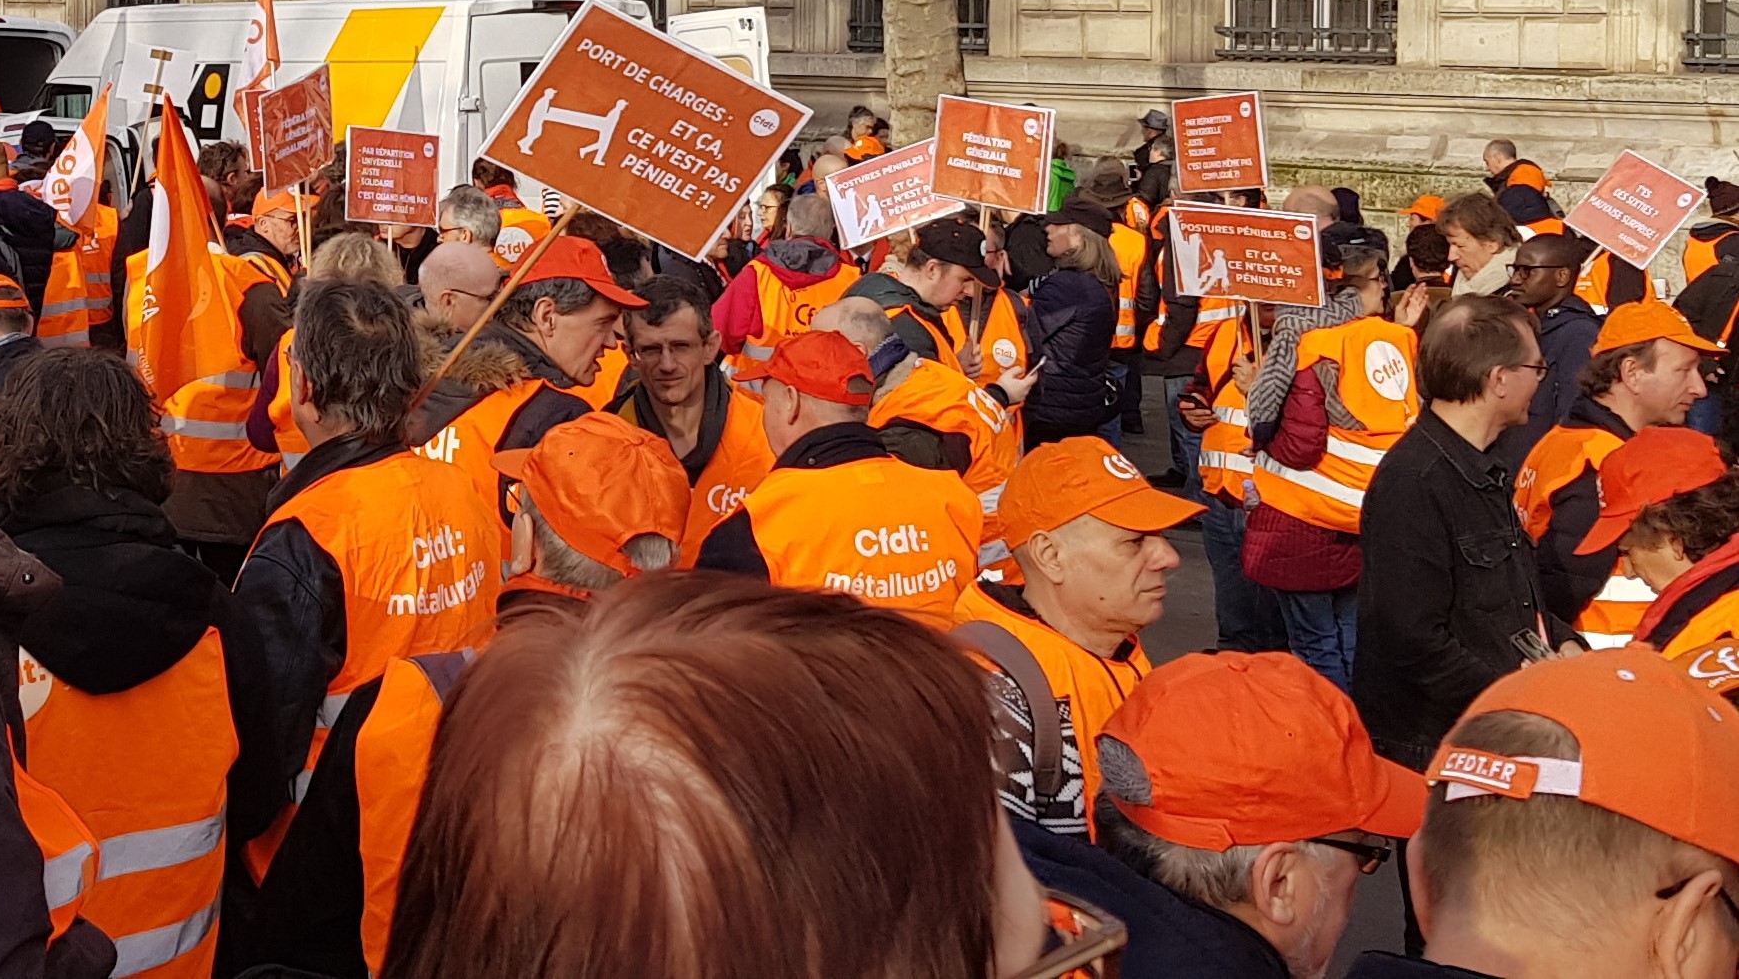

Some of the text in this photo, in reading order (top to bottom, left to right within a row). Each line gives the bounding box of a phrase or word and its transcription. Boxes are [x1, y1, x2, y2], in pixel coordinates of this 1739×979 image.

[577, 38, 627, 70] PORT
[623, 62, 651, 84] DE
[669, 120, 723, 161] ET ÇA,
[620, 153, 698, 201] PÉNIBLE
[627, 128, 742, 193] CE N'EST PAS
[880, 197, 893, 208] CE
[892, 180, 905, 193] ET
[1181, 223, 1235, 234] POSTURES
[1228, 261, 1302, 276] CE N'EST PAS
[1245, 249, 1260, 259] ET
[1235, 272, 1284, 287] PÉNIBLE
[413, 524, 465, 569] Cfdt:
[854, 524, 929, 558] Cfdt:
[387, 560, 485, 616] métallurgie
[825, 558, 957, 598] métallurgie
[1445, 751, 1517, 781] CFDT.FR
